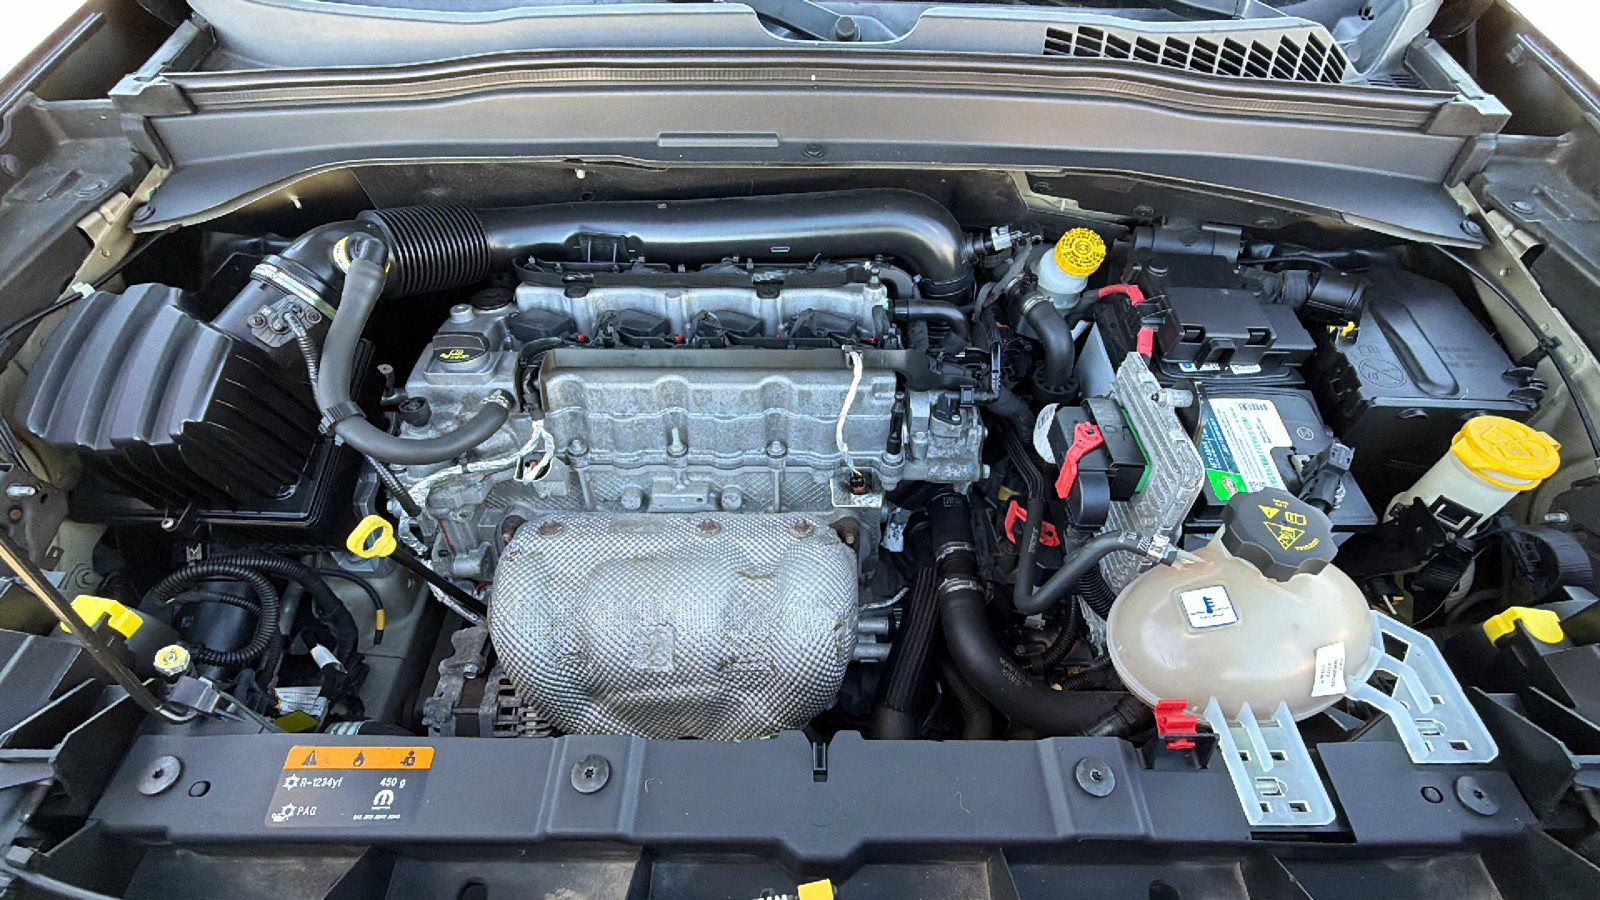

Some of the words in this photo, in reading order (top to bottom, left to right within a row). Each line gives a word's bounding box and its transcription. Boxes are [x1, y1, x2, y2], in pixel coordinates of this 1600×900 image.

[300, 777, 344, 789] R-1234yf
[380, 777, 398, 787] 450
[399, 779, 406, 789] g
[296, 806, 318, 816] PAG
